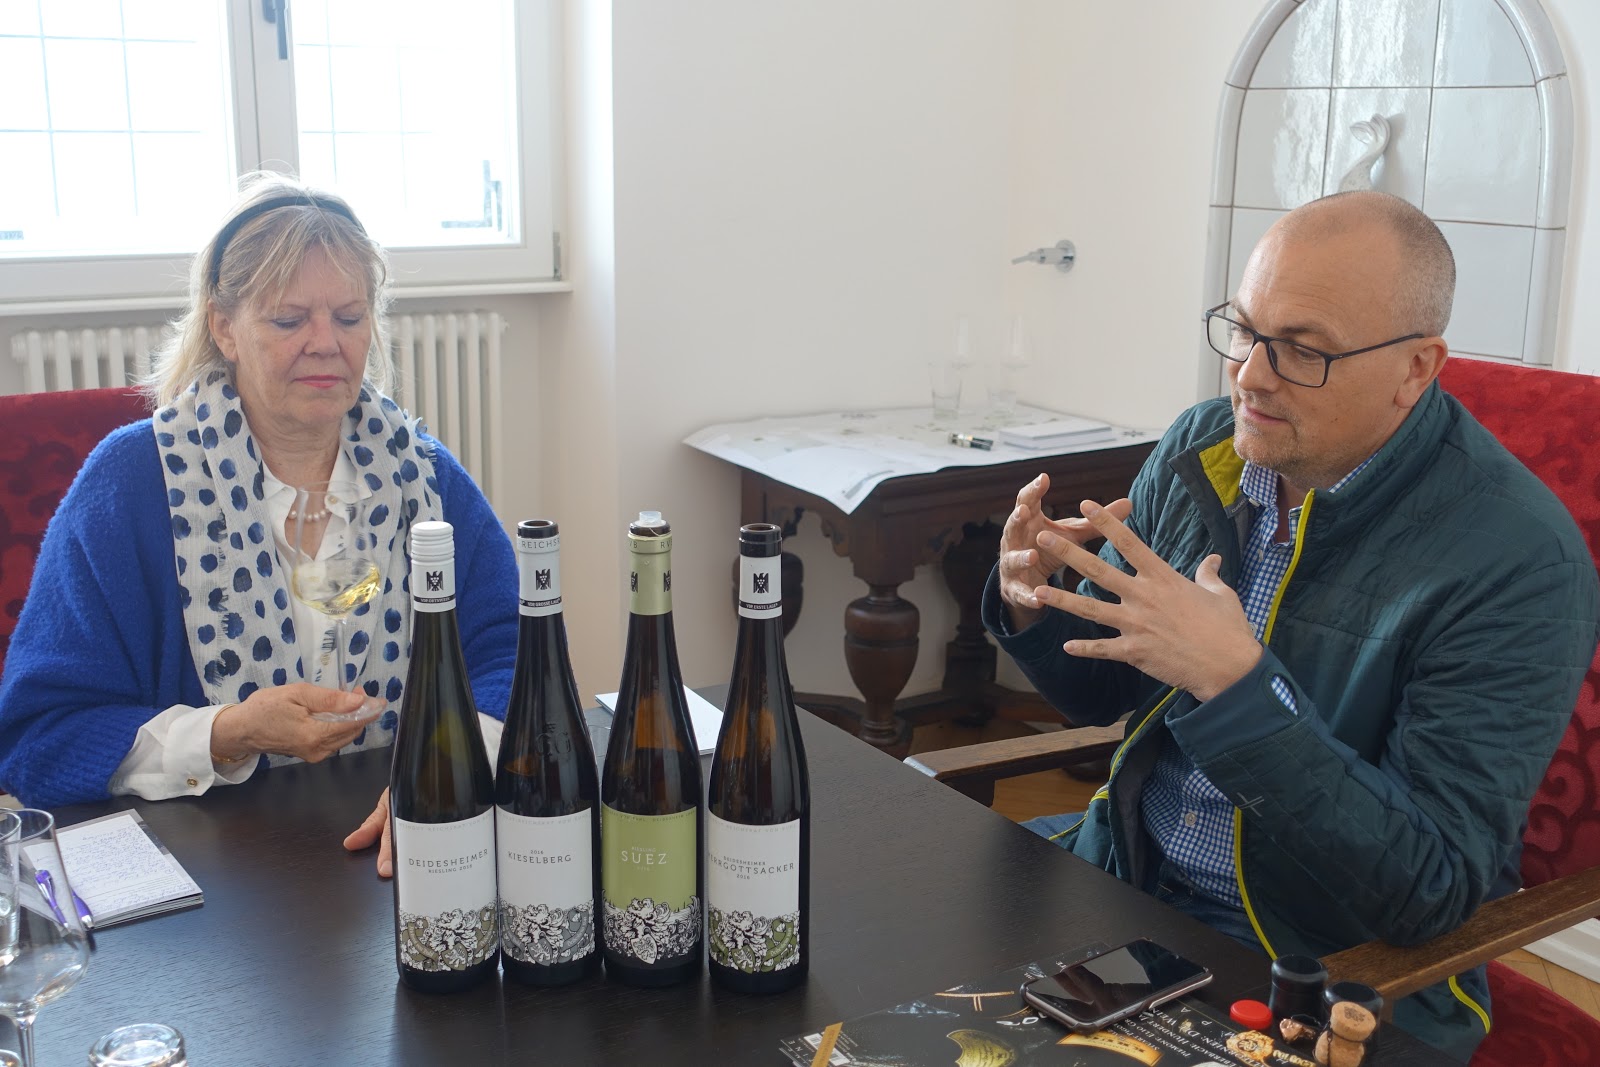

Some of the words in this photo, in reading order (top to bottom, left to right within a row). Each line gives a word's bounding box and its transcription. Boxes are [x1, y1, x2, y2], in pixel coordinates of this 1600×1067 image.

[408, 848, 489, 868] DEIDESHEIMER
[508, 850, 572, 864] KIESELBERG
[621, 850, 667, 865] SUEZ
[723, 855, 766, 866] DEIDESHEIMER
